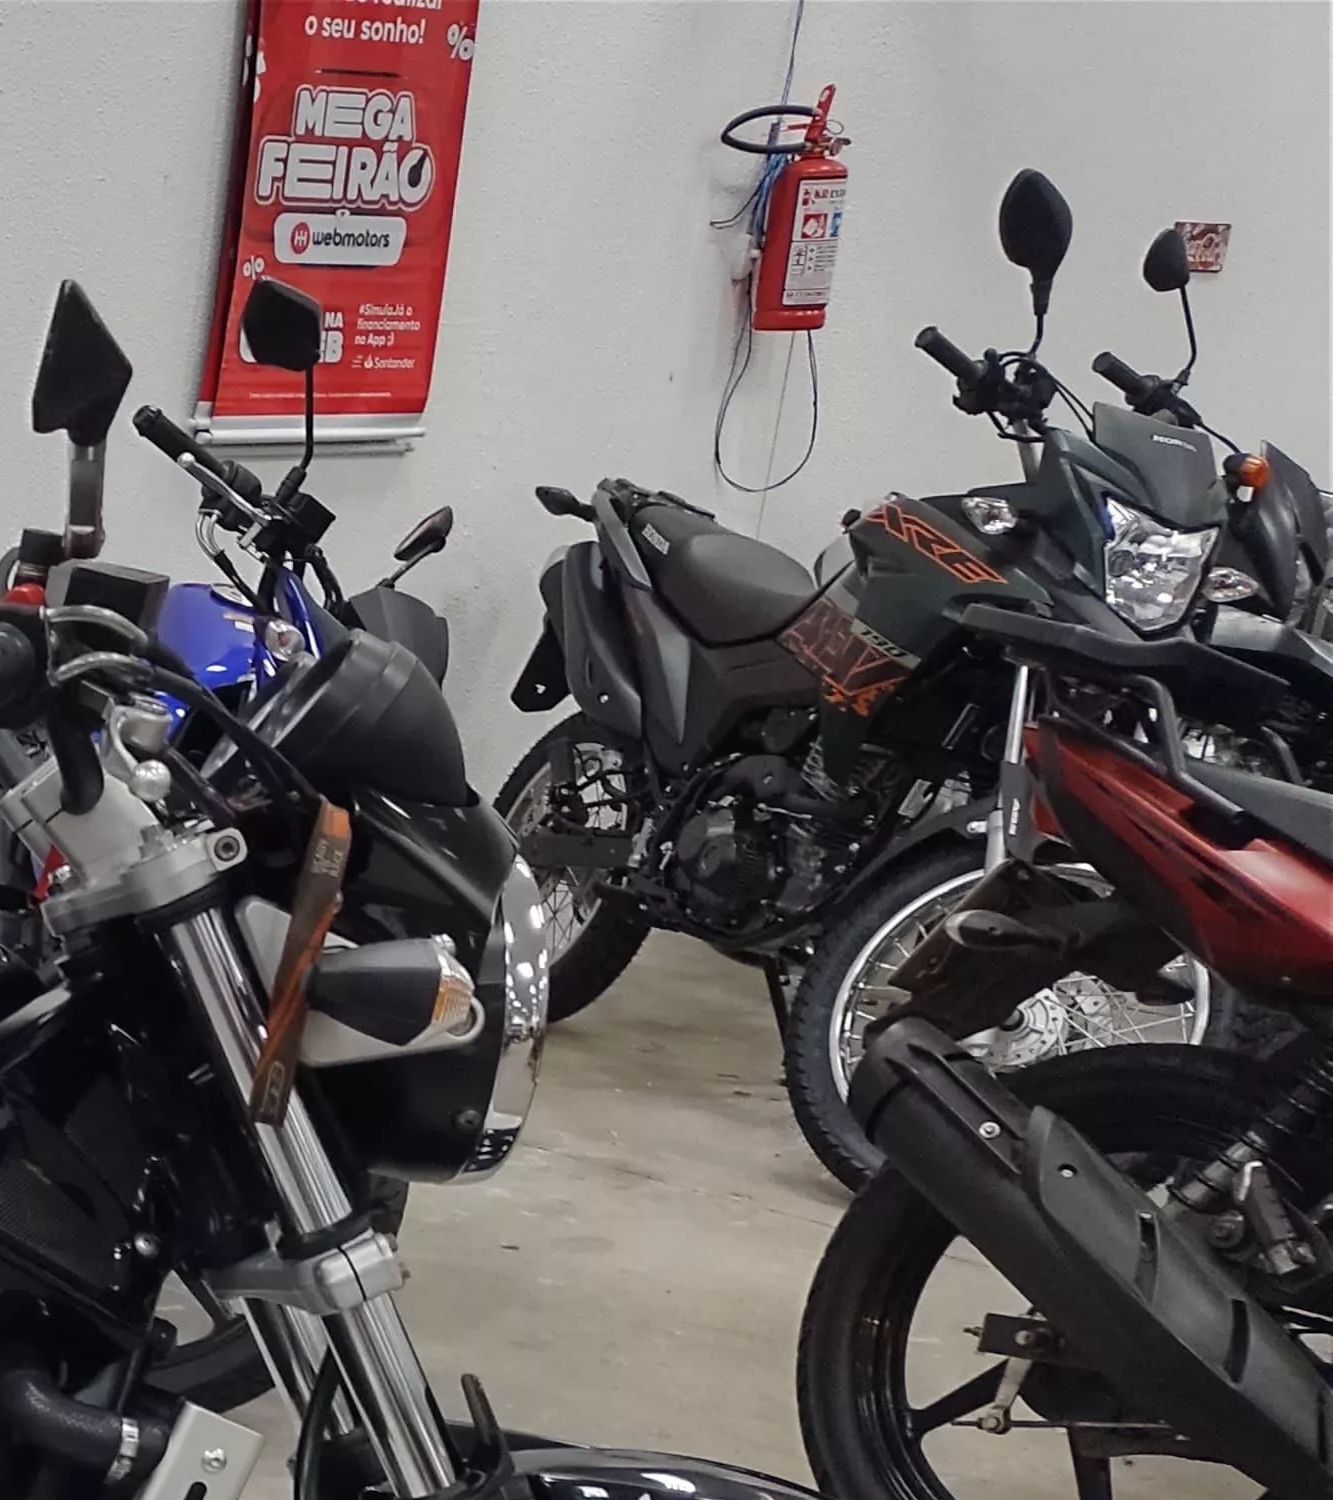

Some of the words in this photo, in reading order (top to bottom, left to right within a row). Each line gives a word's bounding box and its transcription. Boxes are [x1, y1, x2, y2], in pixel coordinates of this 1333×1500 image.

[304, 15, 318, 36] o
[321, 17, 356, 40] seu
[360, 16, 426, 45] sonho!
[295, 89, 414, 142] MEGA
[257, 141, 433, 204] FEIRÃO
[312, 227, 390, 249] webmotors
[324, 311, 344, 329] NA
[373, 356, 416, 369] Santander
